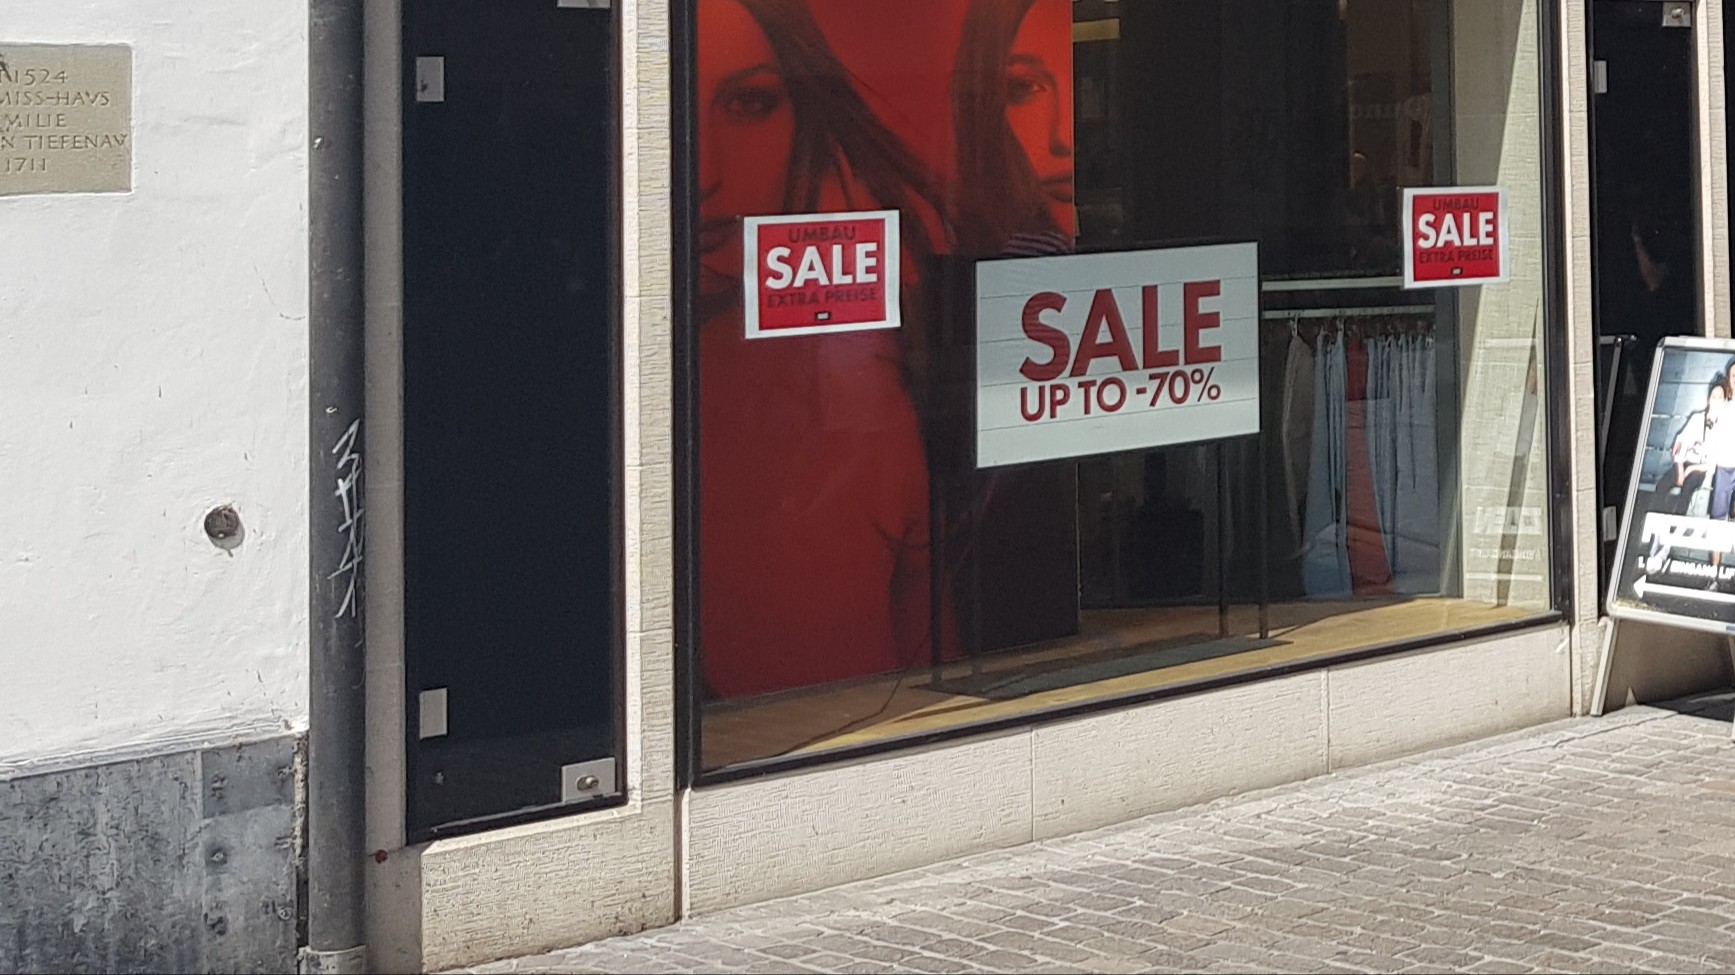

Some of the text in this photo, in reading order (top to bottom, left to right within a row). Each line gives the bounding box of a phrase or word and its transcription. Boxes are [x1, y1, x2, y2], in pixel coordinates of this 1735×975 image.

[1432, 197, 1480, 211] UMBAU
[788, 225, 857, 243] UMBAU
[1417, 211, 1494, 249] SALE
[765, 242, 878, 290] SALE
[1419, 248, 1494, 264] EXTRA PREISE
[767, 287, 878, 308] EXTRA PREISE
[1019, 279, 1222, 383] SALE
[1020, 366, 1222, 422] UP TO -70%
